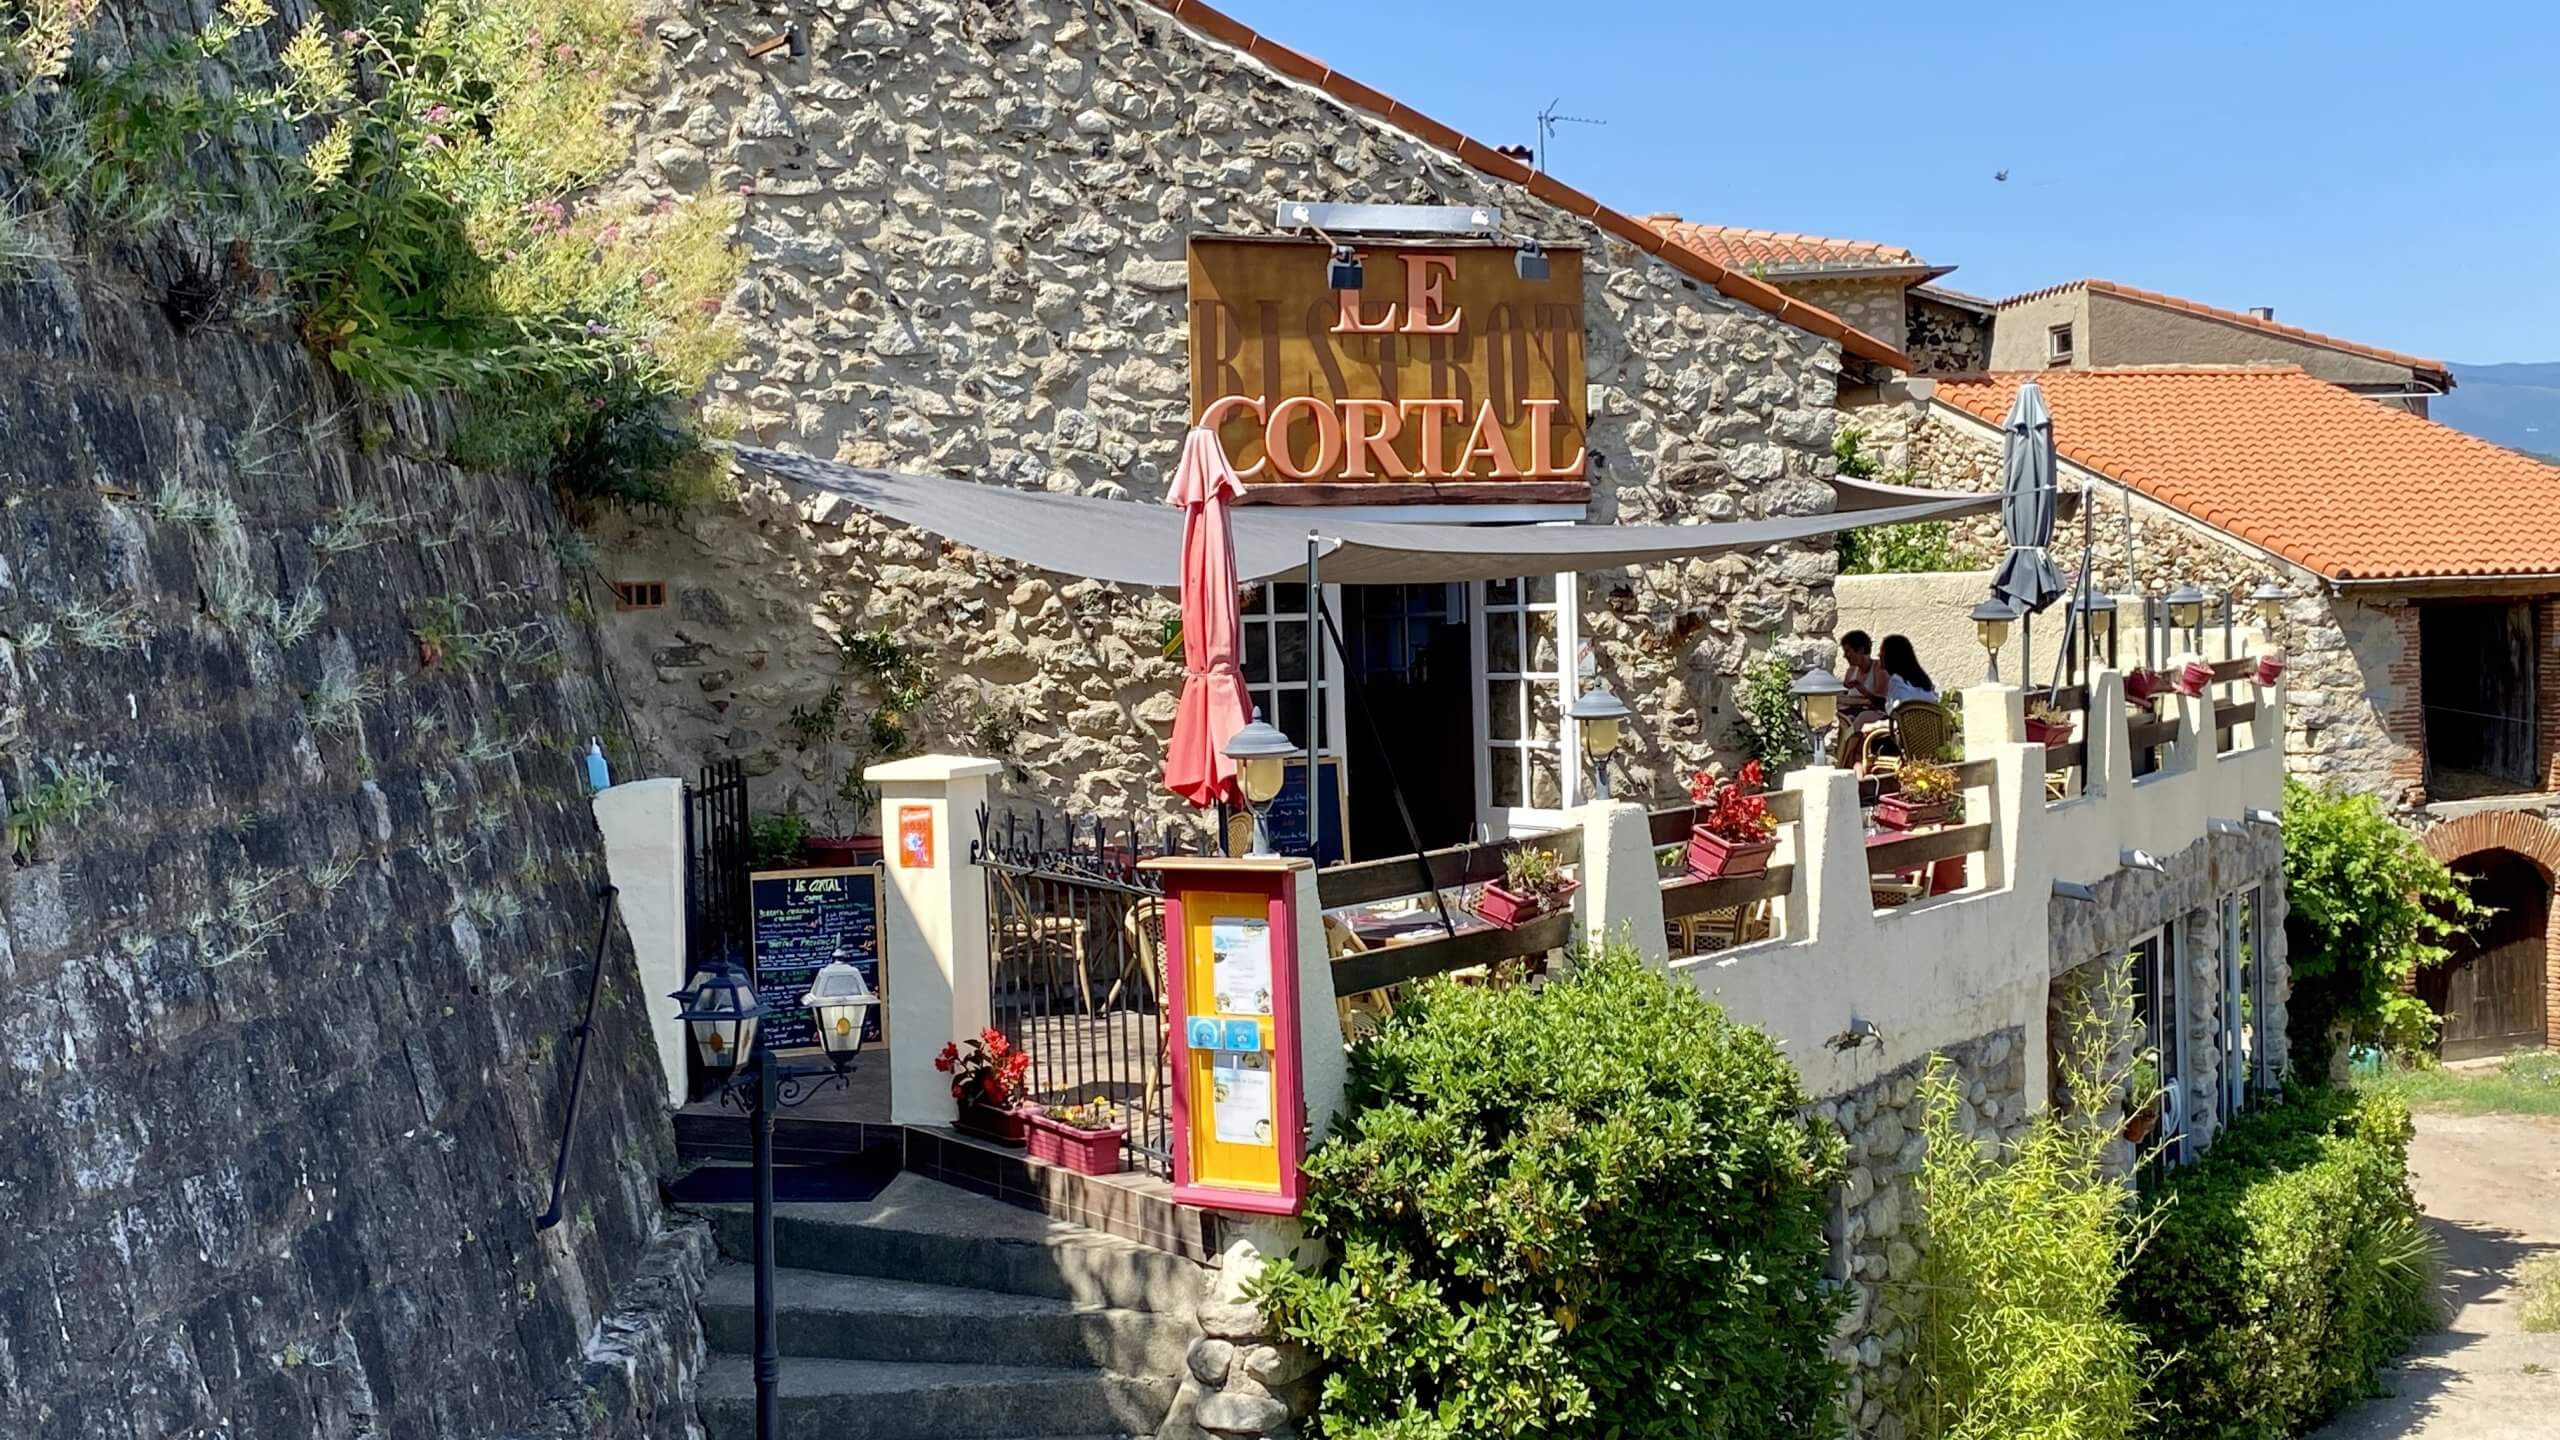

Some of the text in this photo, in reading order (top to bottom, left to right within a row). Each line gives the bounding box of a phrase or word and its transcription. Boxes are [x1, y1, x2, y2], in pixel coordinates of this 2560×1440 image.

[1329, 253, 1462, 334] LE
[1199, 394, 1585, 480] CORTAL
[794, 879, 807, 893] LE
